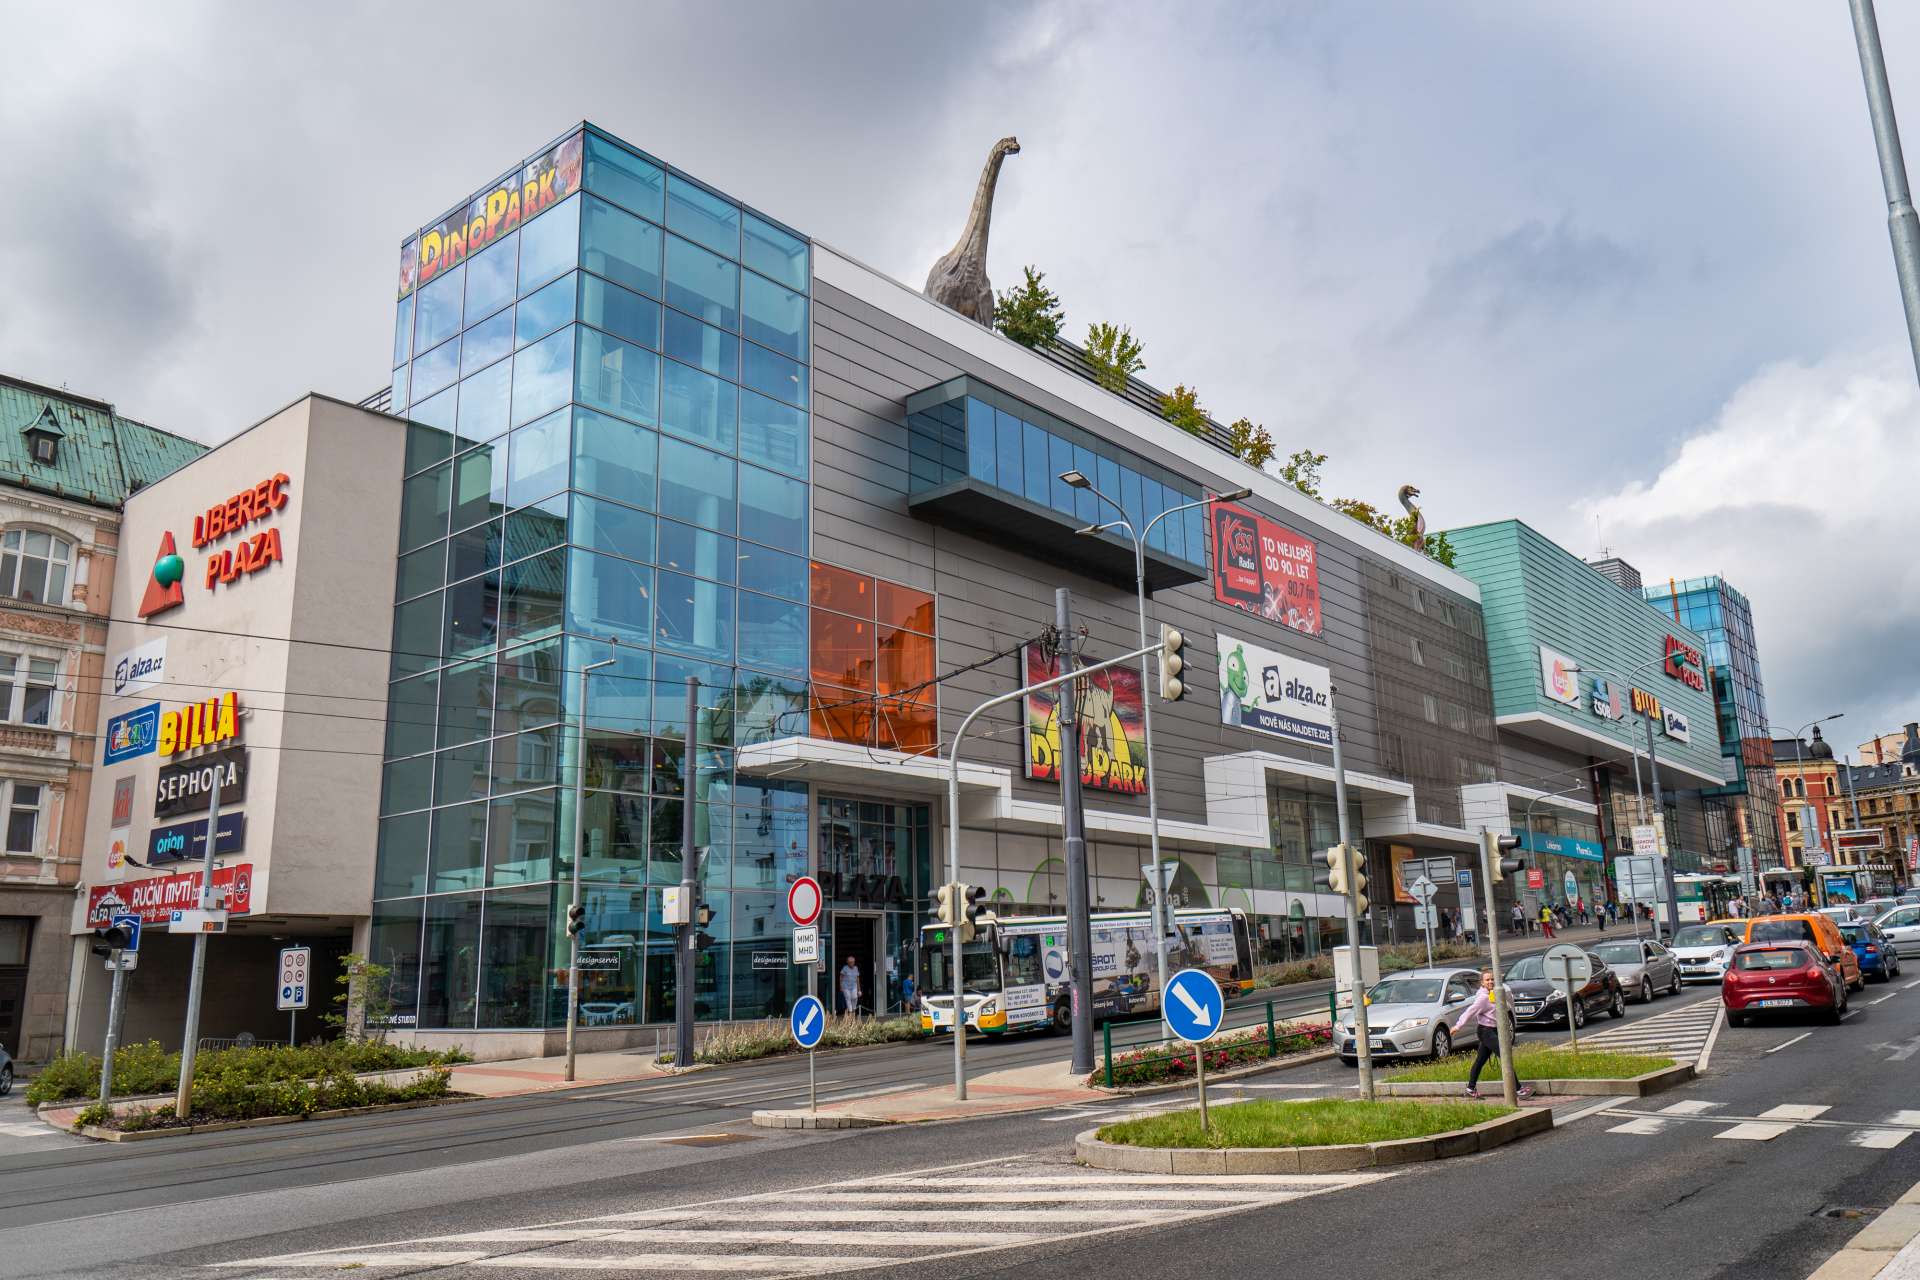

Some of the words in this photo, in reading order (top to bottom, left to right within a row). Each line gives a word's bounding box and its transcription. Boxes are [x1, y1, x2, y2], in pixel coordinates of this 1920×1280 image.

[192, 473, 290, 549] LIBEREC
[206, 528, 283, 590] PLAZA
[1238, 555, 1255, 570] Radio
[1262, 536, 1275, 551] TO
[1277, 540, 1313, 565] NEJLEPŠÍ
[1265, 556, 1279, 572] OD
[1281, 561, 1295, 578] 90.
[1296, 565, 1309, 580] LET
[129, 654, 163, 680] alza.cz
[1682, 668, 1704, 691] PLAZA
[1285, 677, 1327, 707] alza.cz
[1632, 687, 1662, 720] BILLA
[160, 691, 238, 757] BILLA
[1259, 714, 1277, 728] NOVĚ
[1278, 716, 1291, 731] NÁS
[1292, 721, 1318, 738] NAJDETE
[1319, 729, 1330, 741] ZDE
[1031, 733, 1147, 793] DIPARK
[159, 762, 237, 802] SEPHORA
[157, 830, 185, 854] orion
[132, 879, 165, 907] RUČNÍ
[165, 875, 193, 904] MYTÍ
[818, 871, 906, 902] PLAZA
[90, 908, 109, 923] ALFA
[797, 935, 814, 943] MIMO
[799, 947, 813, 955] MHD
[577, 956, 618, 966] designservis
[753, 956, 788, 965] designservis
[398, 1015, 416, 1024] STUDIO
